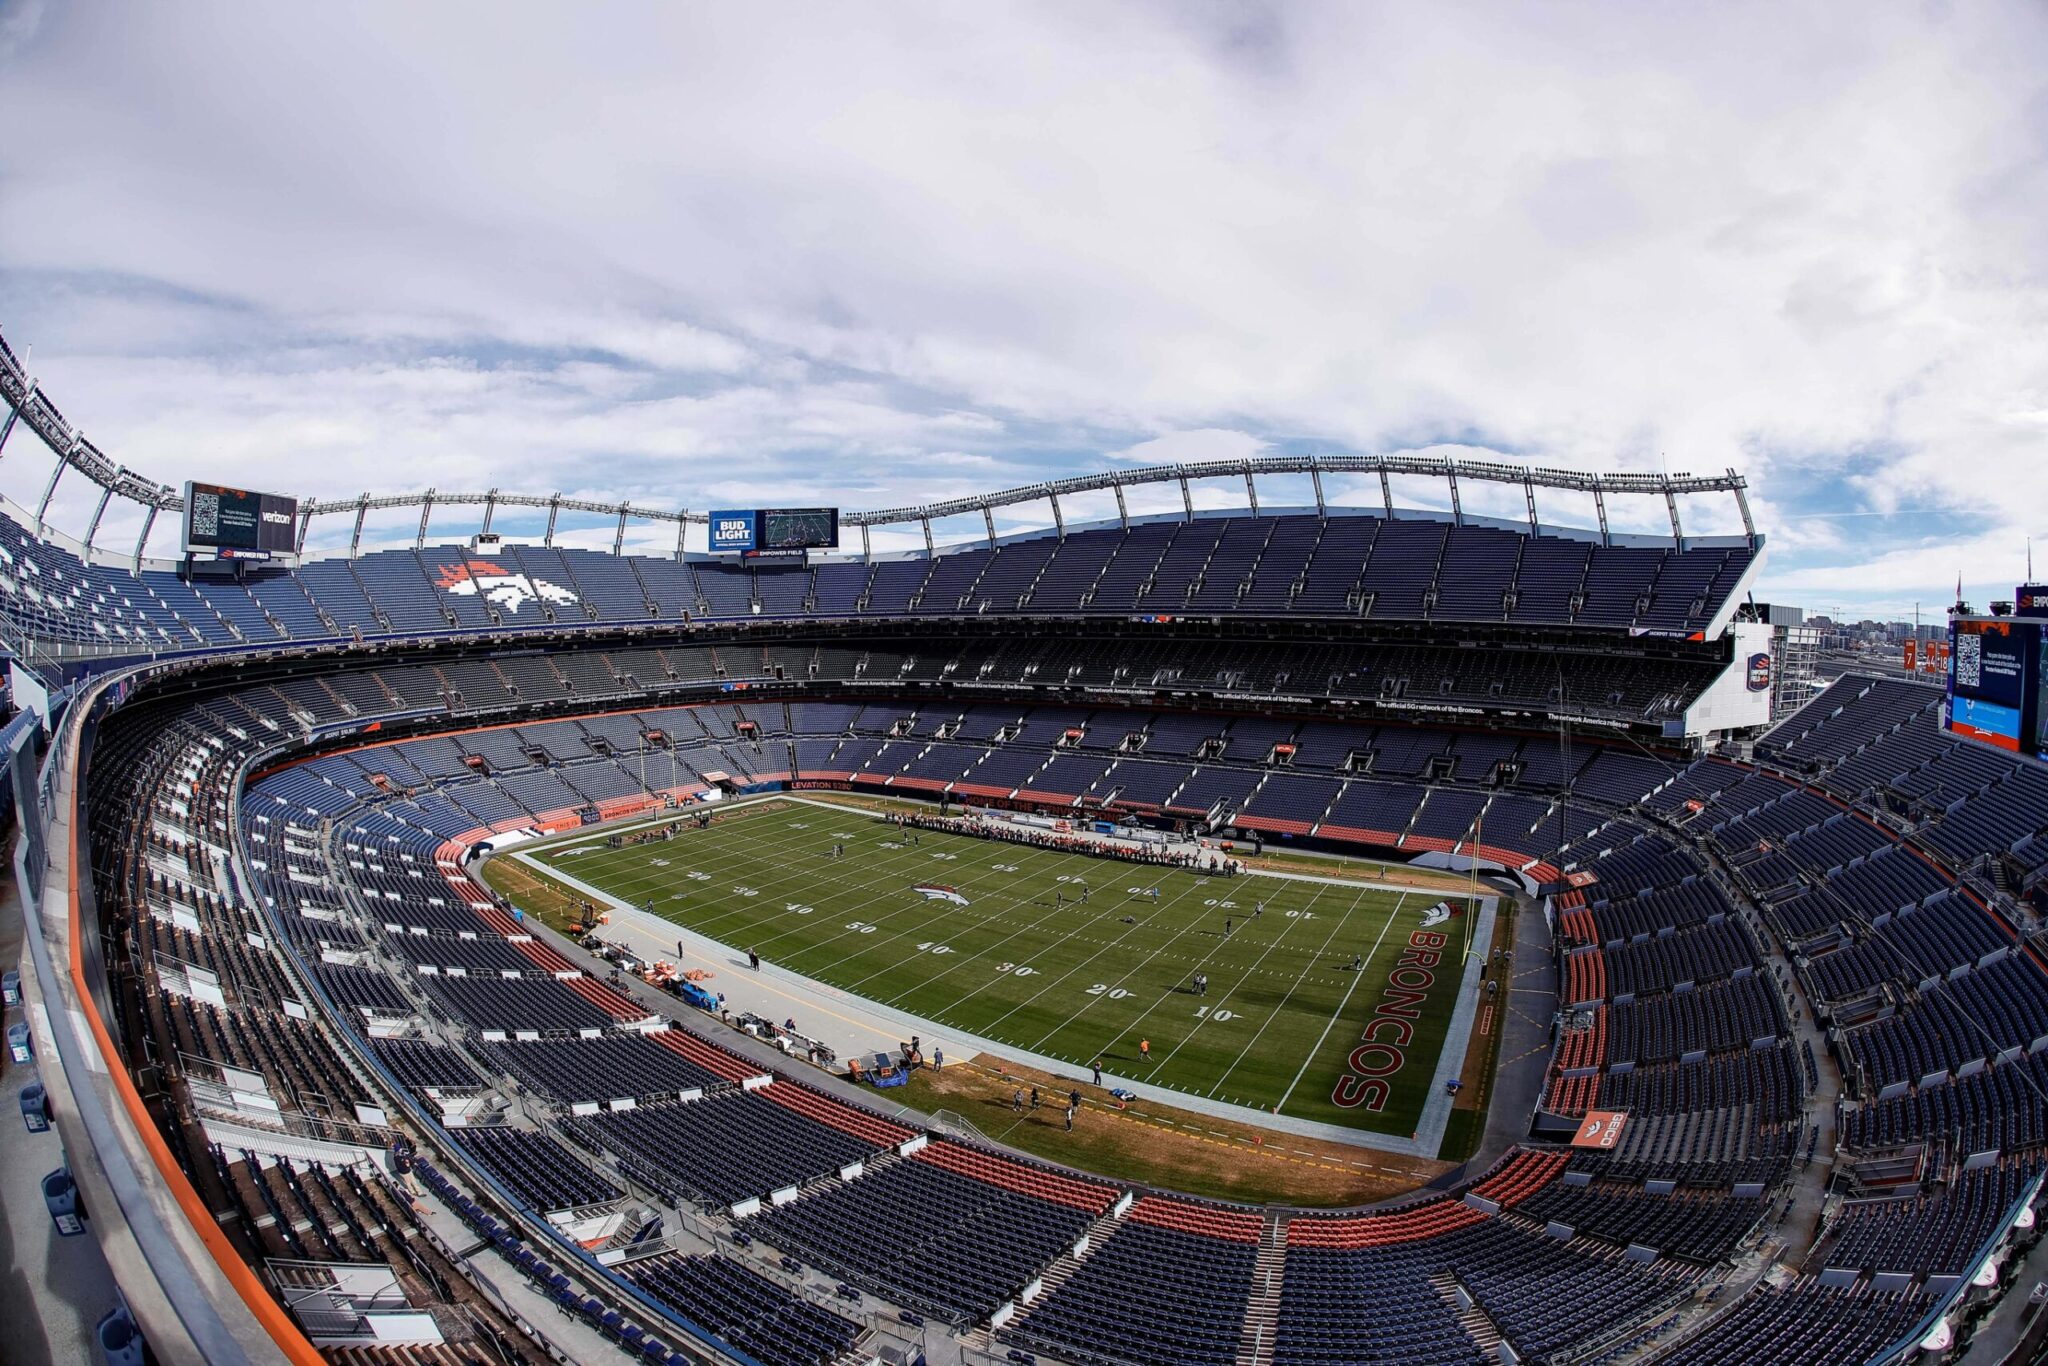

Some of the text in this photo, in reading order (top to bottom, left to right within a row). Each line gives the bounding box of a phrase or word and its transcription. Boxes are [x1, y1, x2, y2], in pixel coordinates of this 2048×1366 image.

[262, 510, 290, 525] verizon
[720, 521, 746, 531] BUD
[715, 529, 751, 540] LIGHT
[1907, 652, 1912, 665] 7
[1940, 656, 1948, 670] 18
[1416, 703, 1441, 711] network
[1582, 717, 1607, 725] America
[1013, 801, 1033, 812] THE
[604, 809, 630, 819] BRONCOS
[733, 886, 759, 896] 30
[786, 902, 814, 914] 40
[845, 921, 877, 933] 50
[916, 941, 950, 955] 40
[995, 962, 1034, 976] 30
[1085, 984, 1128, 999] 20
[1193, 1006, 1235, 1022] 10
[1331, 930, 1448, 1112] BRONCOS
[1600, 1114, 1624, 1146] GEICO
